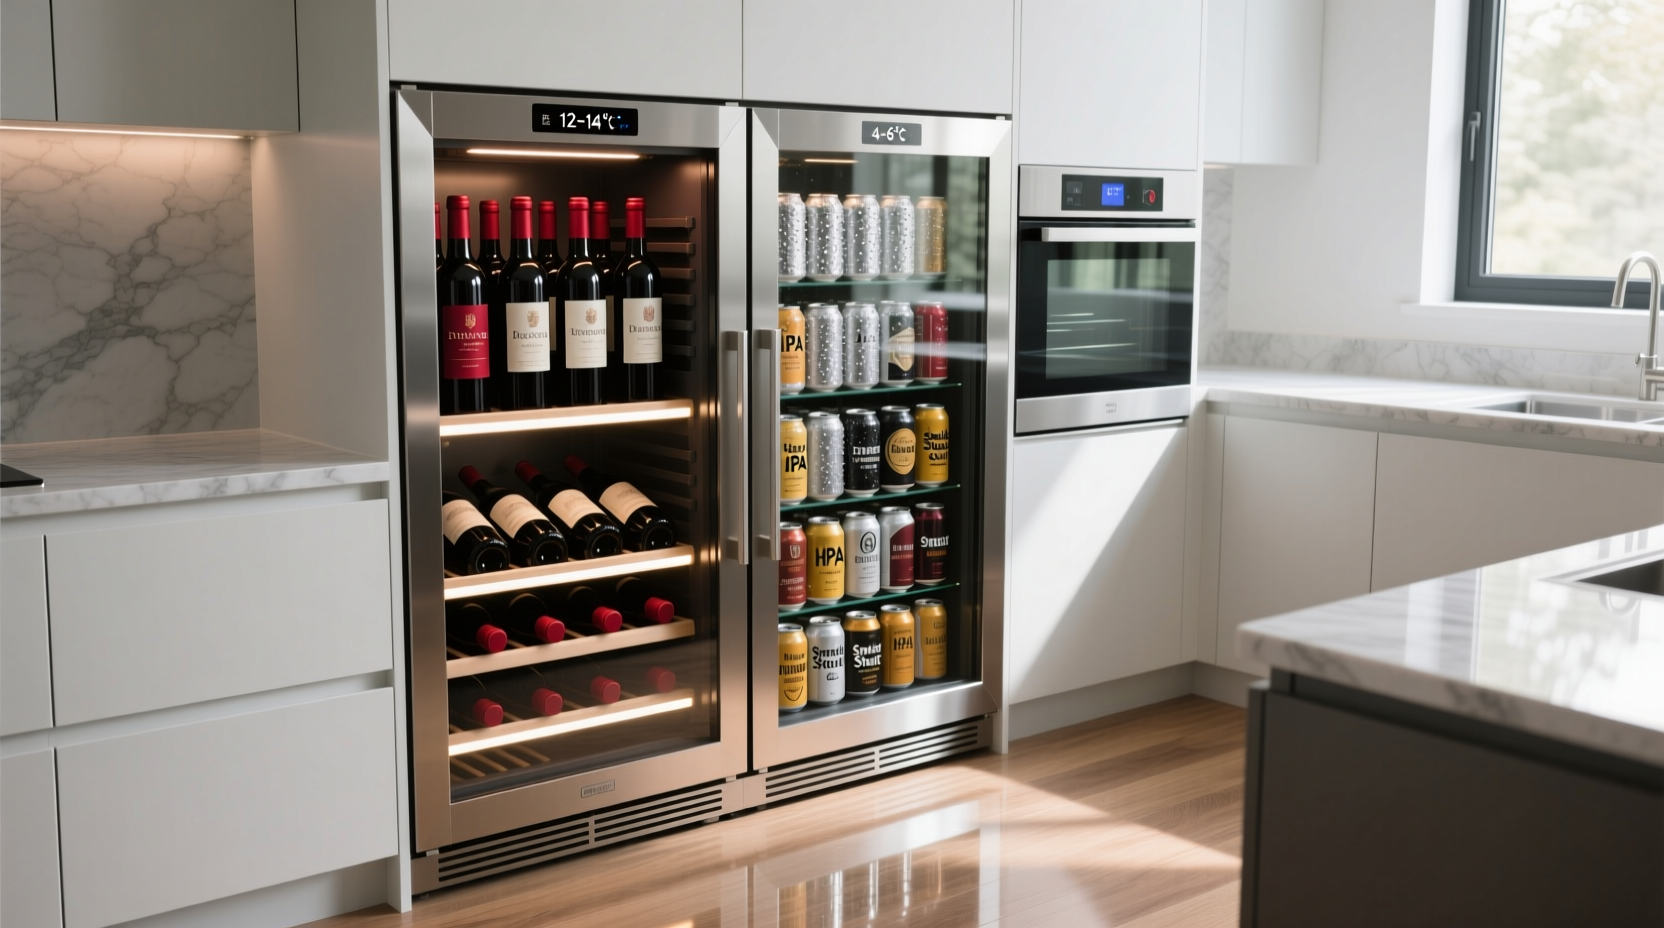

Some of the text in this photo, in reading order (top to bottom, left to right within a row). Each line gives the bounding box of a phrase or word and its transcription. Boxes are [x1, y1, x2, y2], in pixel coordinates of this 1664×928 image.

[785, 455, 807, 473] IPA
[815, 546, 844, 567] HPA
[893, 636, 913, 651] IPA
